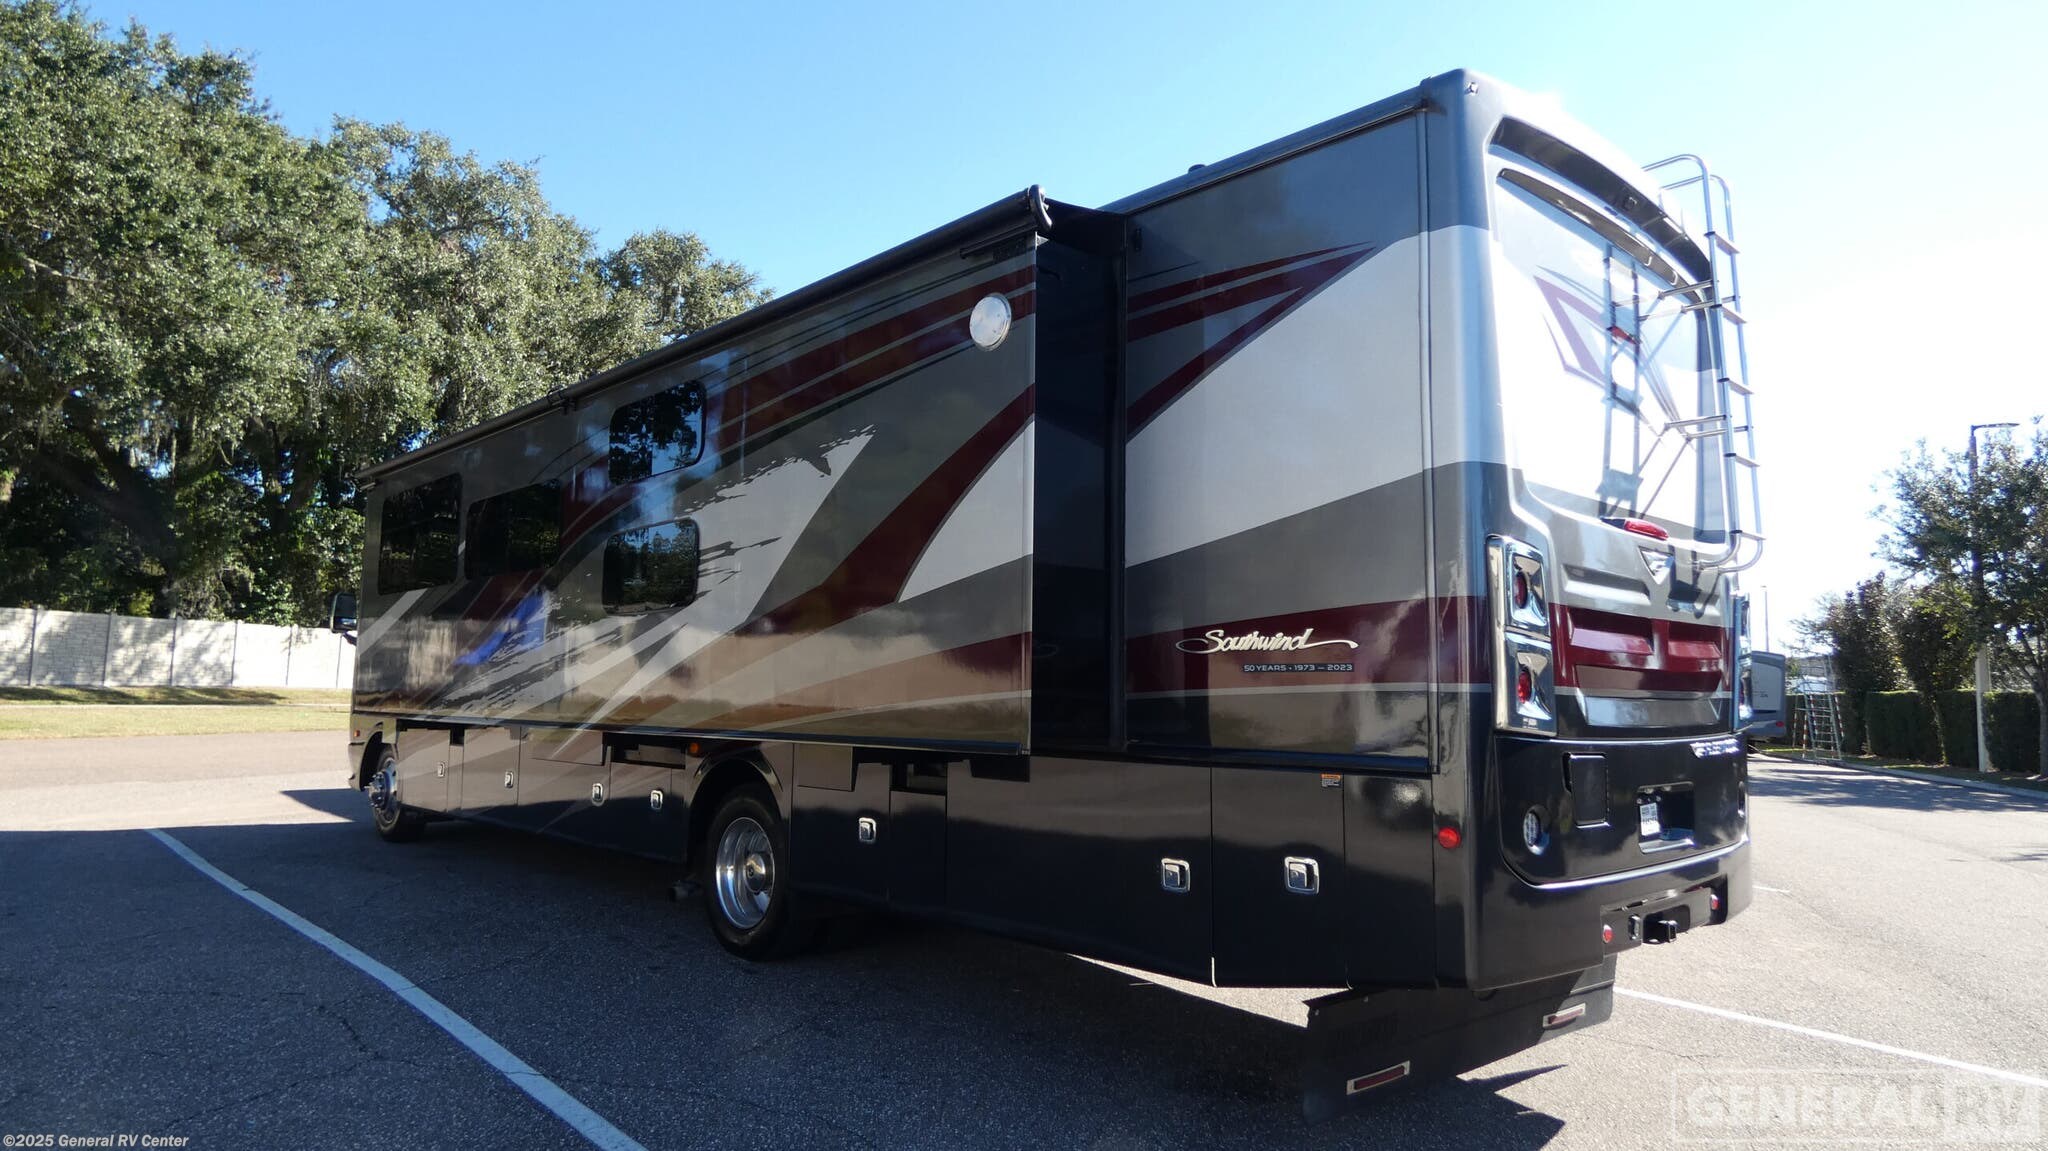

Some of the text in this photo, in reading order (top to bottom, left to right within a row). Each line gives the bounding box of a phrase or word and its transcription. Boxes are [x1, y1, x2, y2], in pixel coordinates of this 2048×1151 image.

[1176, 628, 1359, 654] Southwind
[1244, 664, 1255, 672] 50
[1255, 664, 1287, 672] YEARS
